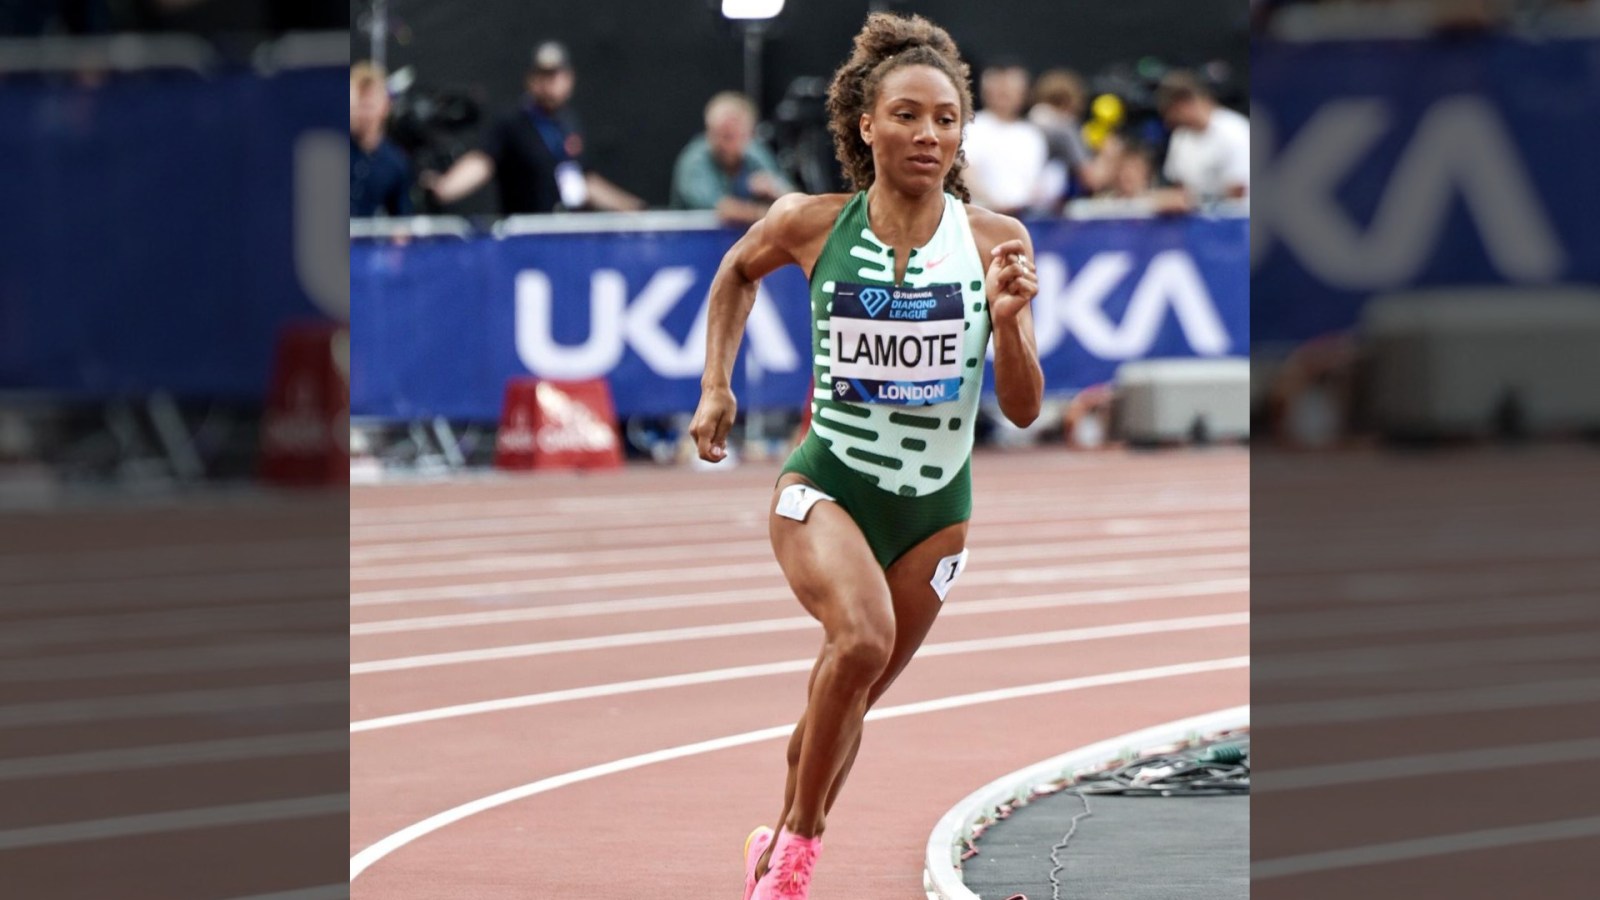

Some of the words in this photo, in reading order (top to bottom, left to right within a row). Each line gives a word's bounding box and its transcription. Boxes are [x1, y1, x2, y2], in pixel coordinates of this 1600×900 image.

[1250, 97, 1570, 290] KA
[889, 309, 928, 319] LEAGUE
[891, 299, 937, 309] DIAMOND
[515, 266, 799, 379] UKA
[837, 331, 957, 368] LAMOTE
[878, 384, 945, 400] LONDON
[946, 561, 959, 583] 1
